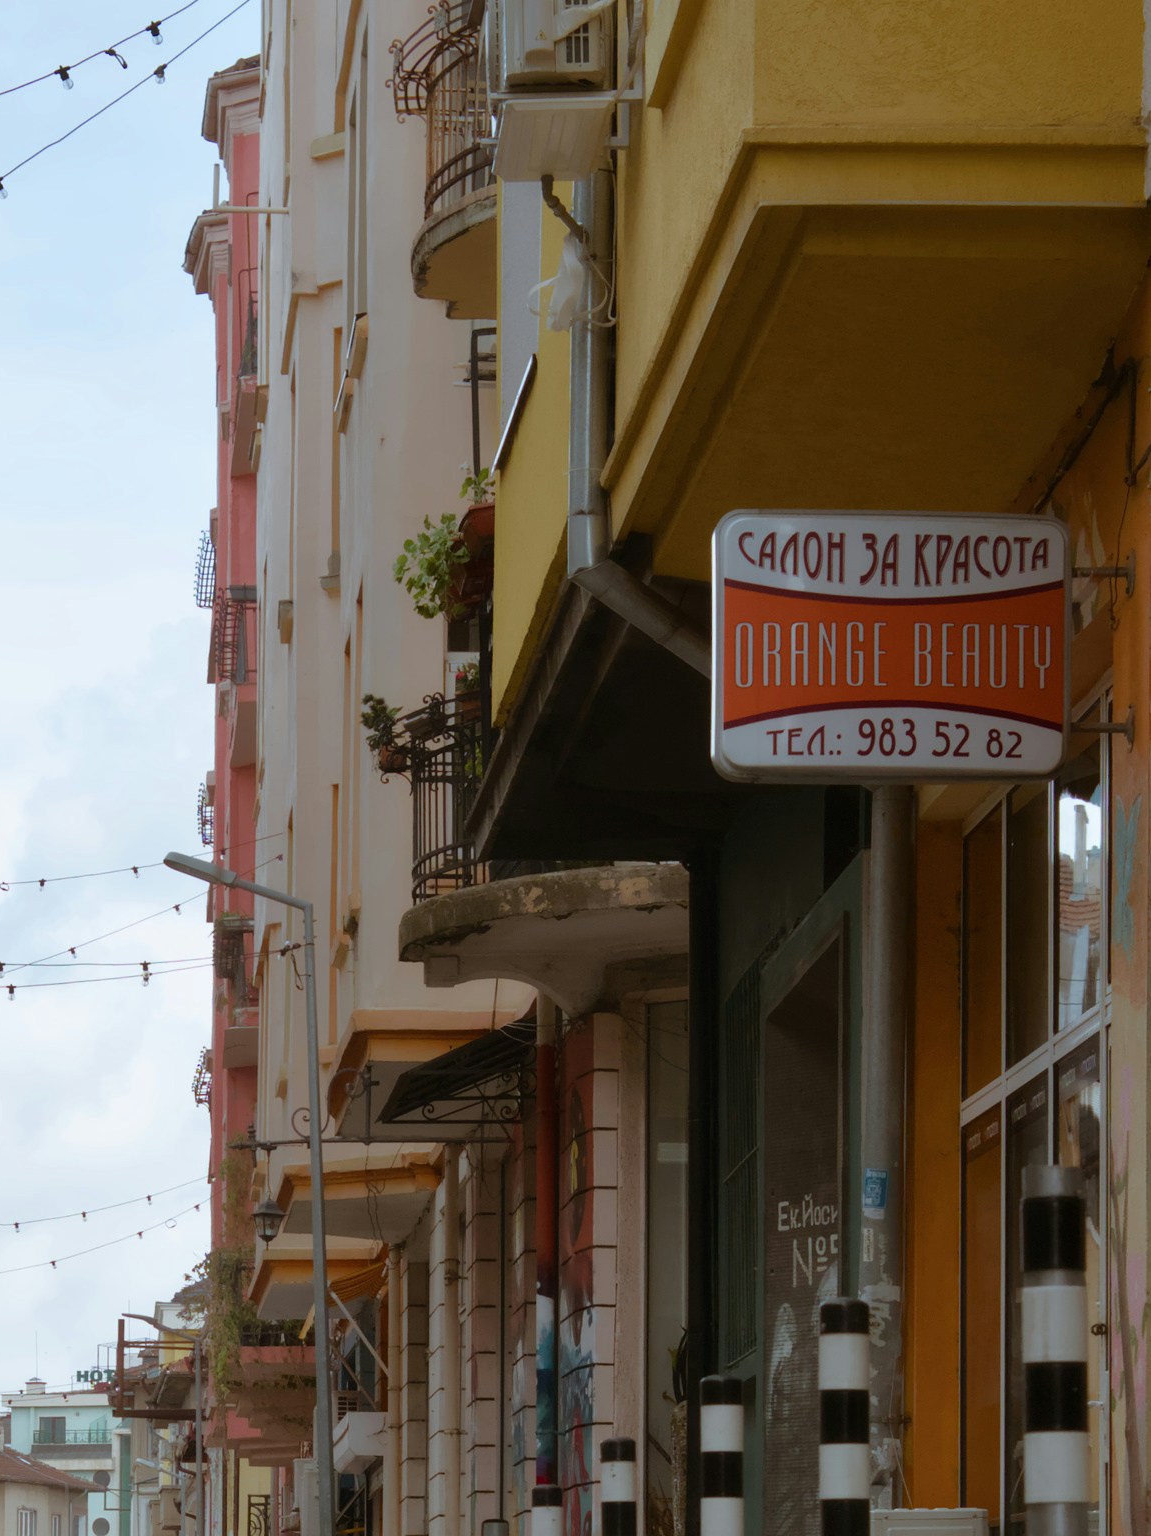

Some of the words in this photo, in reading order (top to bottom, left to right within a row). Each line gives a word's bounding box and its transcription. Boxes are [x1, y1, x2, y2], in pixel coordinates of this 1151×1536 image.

[738, 531, 846, 584] САЛОН
[859, 533, 898, 587] ЗА
[914, 533, 1050, 587] КРАСОТА
[734, 621, 888, 688] ORANGE
[913, 622, 1052, 689] BEAUTY
[766, 727, 842, 757] ТЕЛ.:
[857, 718, 917, 758] 983
[931, 724, 970, 758] 52
[985, 730, 1023, 759] 82
